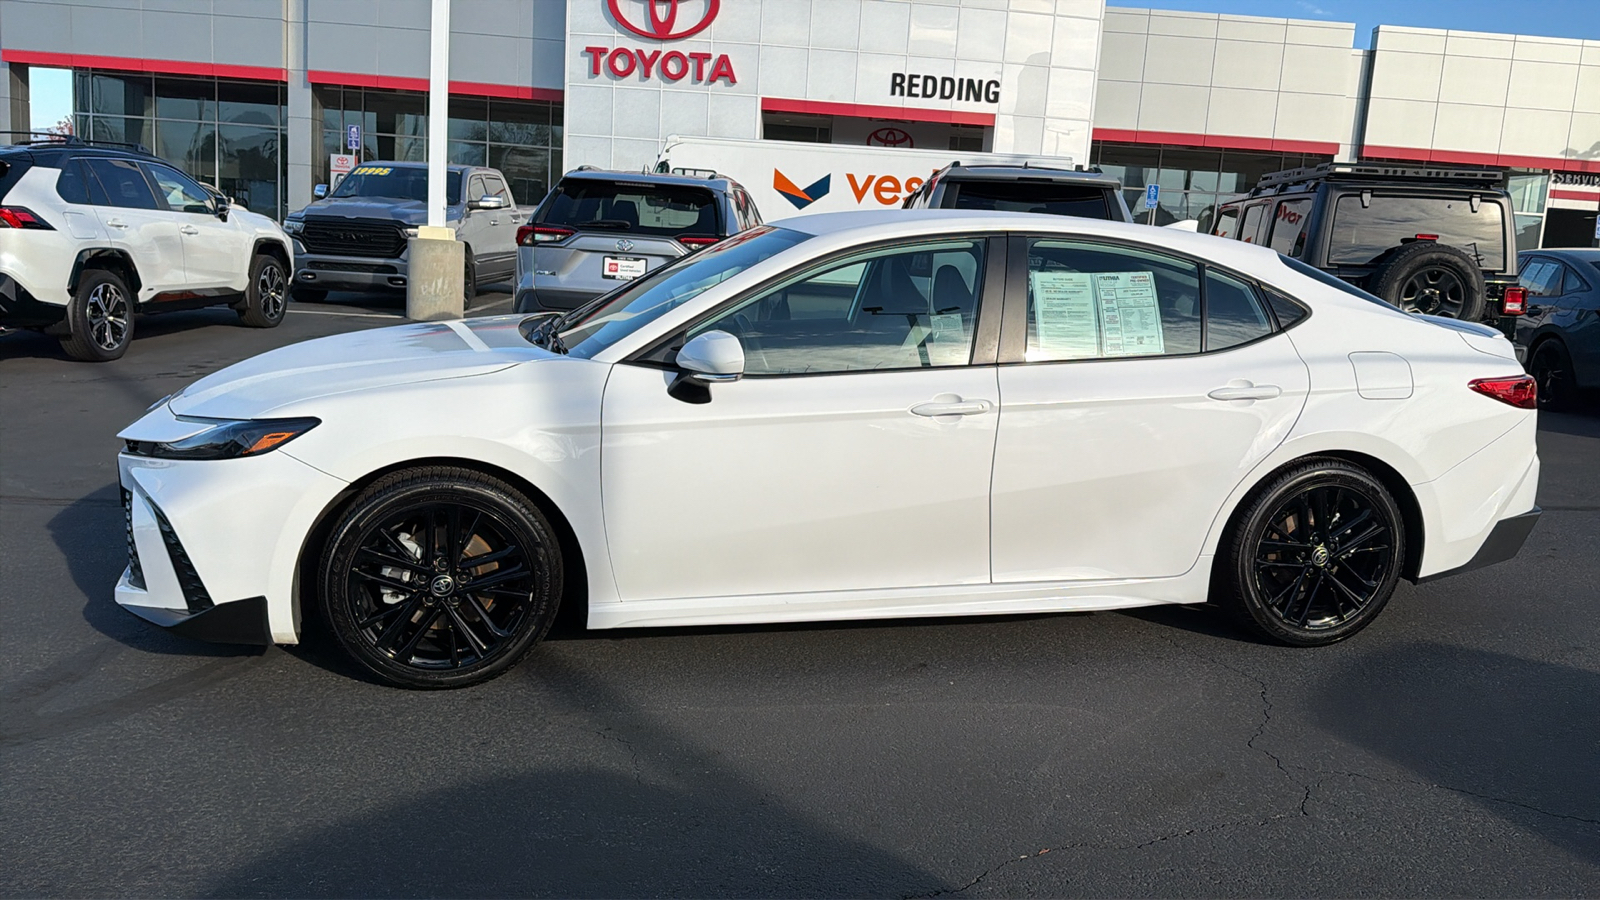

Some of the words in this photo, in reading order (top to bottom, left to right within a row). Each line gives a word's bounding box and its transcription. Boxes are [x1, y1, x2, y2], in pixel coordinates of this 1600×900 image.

[585, 46, 738, 84] TOYOTA
[890, 72, 1000, 104] REDDING
[846, 170, 932, 206] ves
